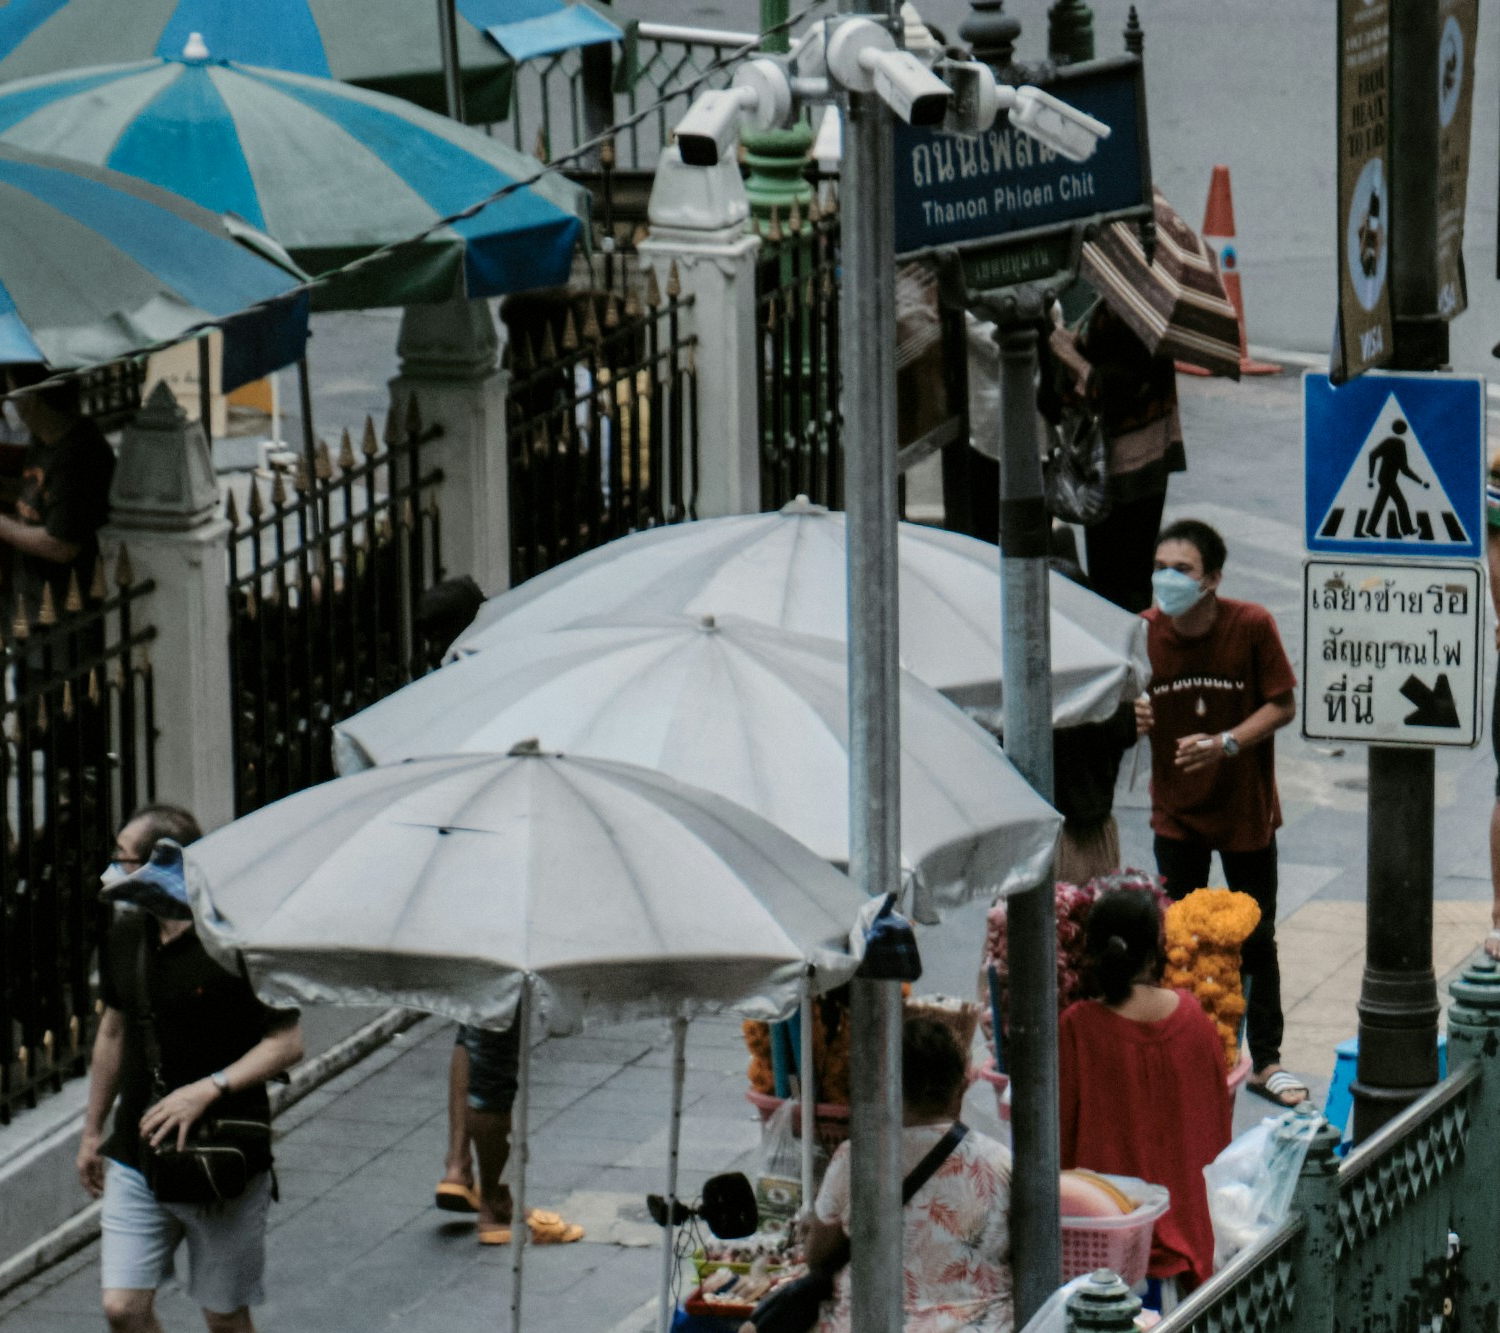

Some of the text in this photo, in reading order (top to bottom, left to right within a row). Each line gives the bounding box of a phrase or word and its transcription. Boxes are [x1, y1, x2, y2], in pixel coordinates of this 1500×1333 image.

[922, 171, 1095, 226] Thanon Phloen Chit
[1322, 627, 1461, 669] สัญญาณไฟ
[1324, 675, 1374, 725] ที่นี่
